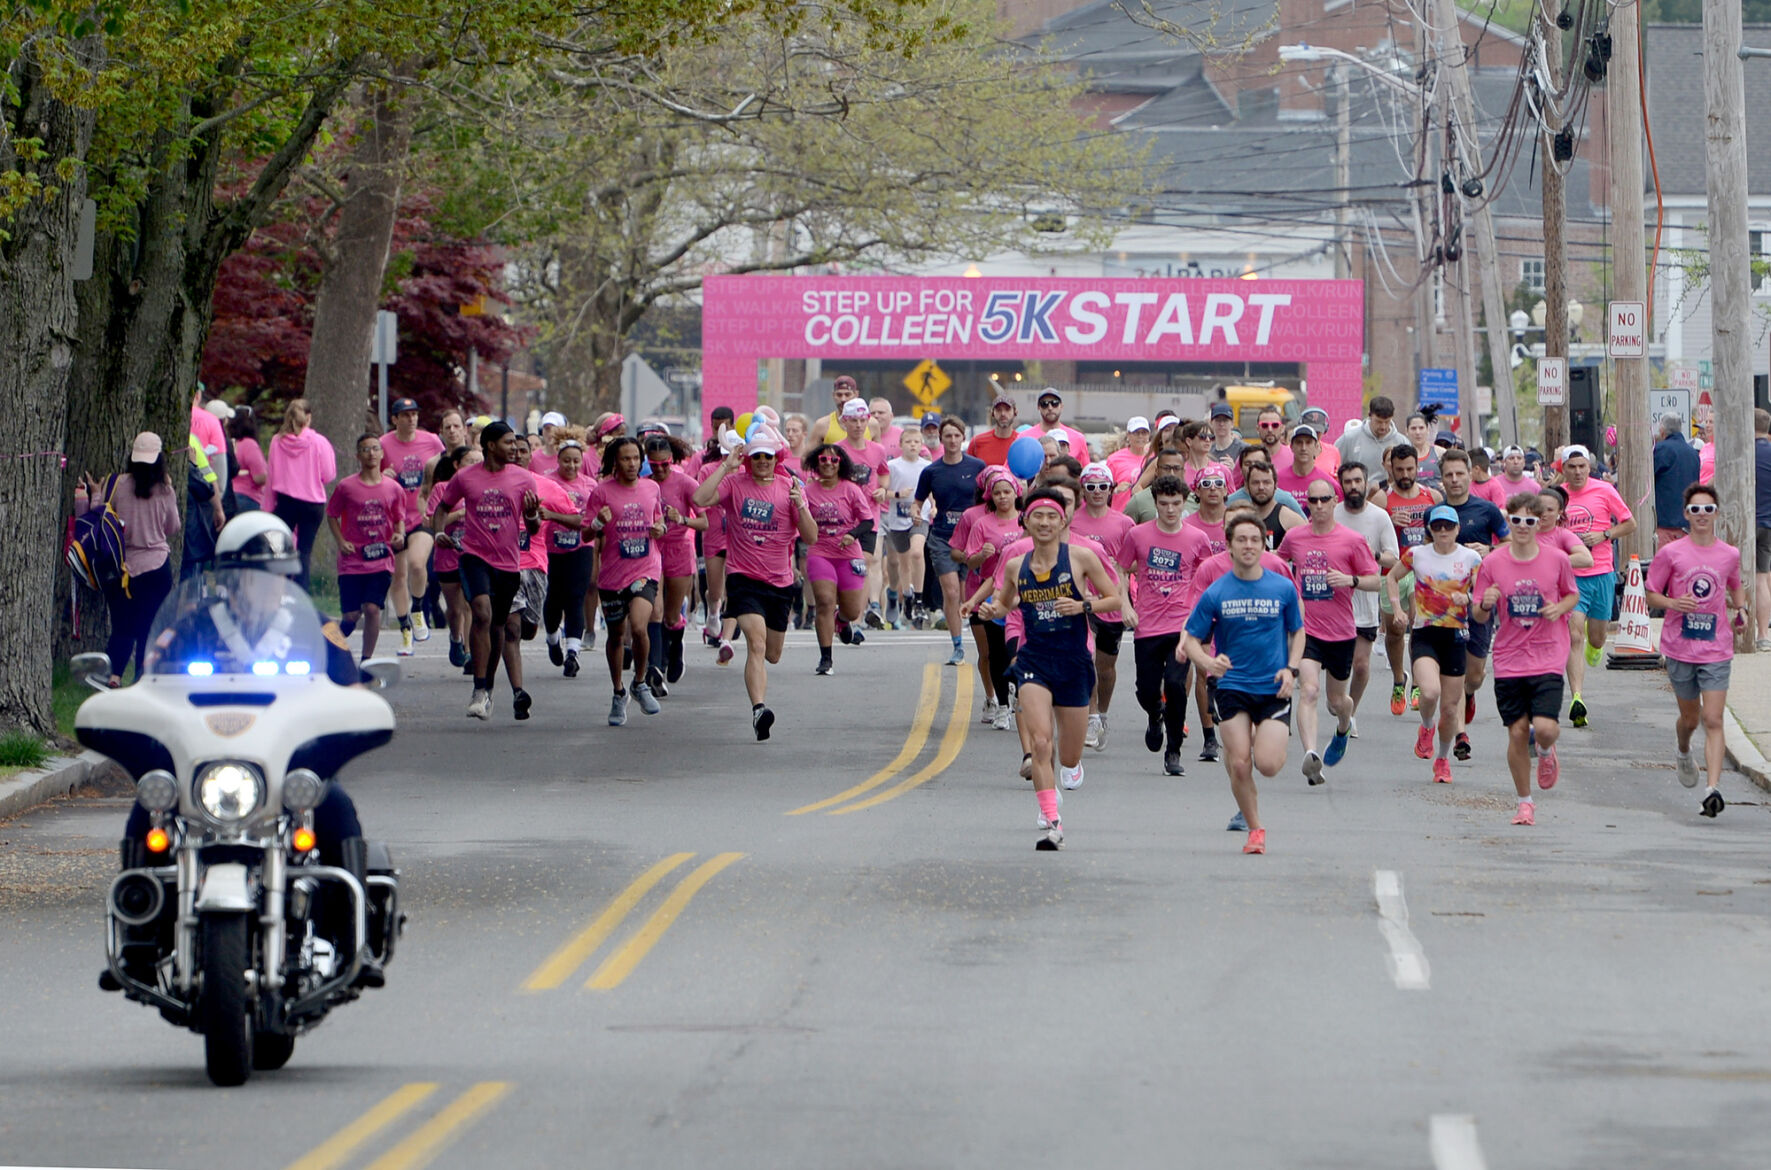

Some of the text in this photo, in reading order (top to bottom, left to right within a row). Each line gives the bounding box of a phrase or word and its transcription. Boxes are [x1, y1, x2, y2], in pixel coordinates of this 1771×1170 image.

[1267, 282, 1362, 297] WALK/RUN
[802, 290, 870, 313] STEP
[877, 290, 913, 314] UP
[919, 289, 973, 313] FOR
[977, 290, 1292, 346] 5K START
[1618, 312, 1636, 327] NO
[804, 313, 974, 346] COLLEEN
[1611, 335, 1641, 347] PARKING
[1280, 343, 1362, 358] COLLEEN
[1544, 367, 1558, 379] NO
[1681, 371, 1691, 379] NO
[1539, 385, 1562, 396] PARKING
[747, 506, 768, 518] 1172
[625, 545, 645, 554] 1203
[1152, 555, 1175, 567] 2073
[1021, 582, 1073, 603] MERRIMACK
[1305, 583, 1328, 592] 2108
[1221, 599, 1253, 609] STRIVE
[1254, 599, 1273, 607] FOR
[1247, 606, 1269, 614] ROAD
[1513, 603, 1538, 613] 2072
[1687, 620, 1712, 631] 3570
